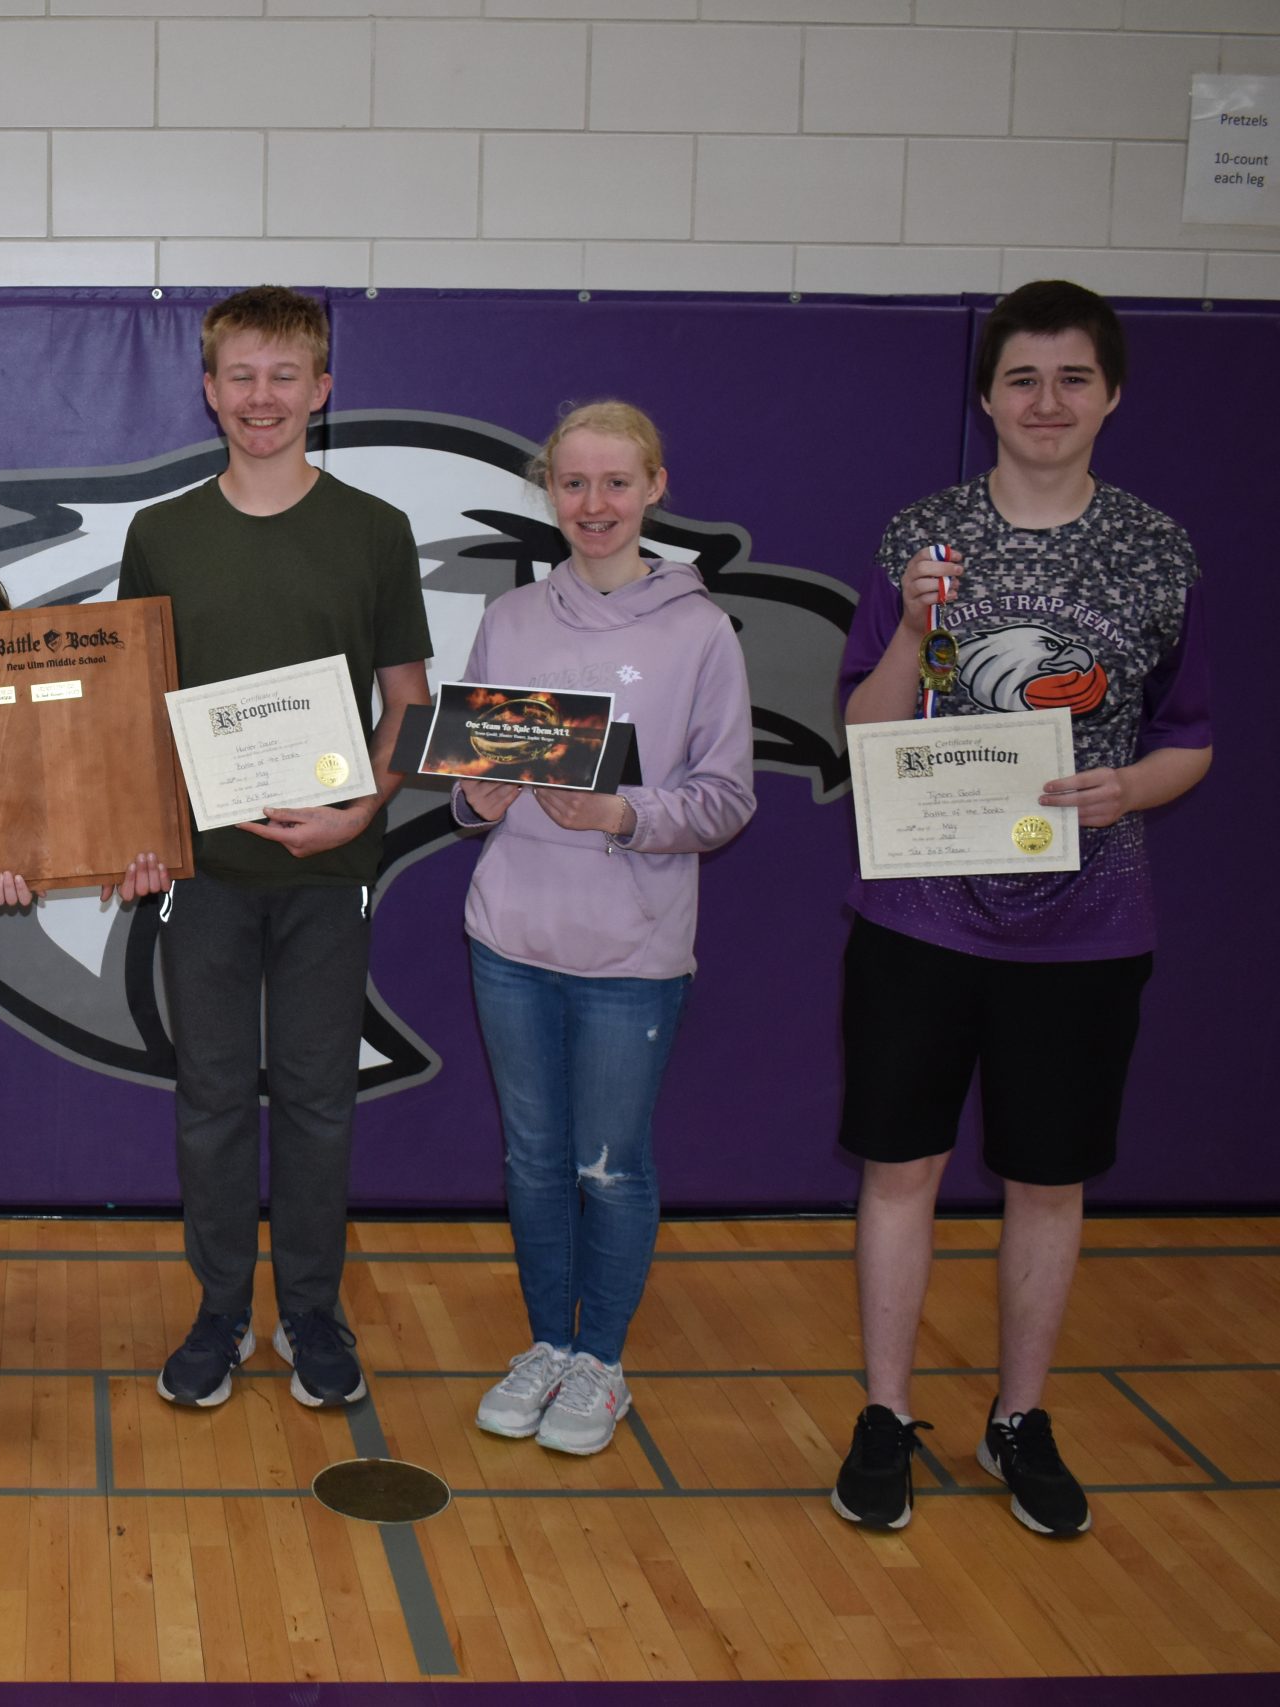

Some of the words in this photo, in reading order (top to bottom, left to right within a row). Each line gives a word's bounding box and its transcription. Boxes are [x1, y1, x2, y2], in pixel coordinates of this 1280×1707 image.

[1220, 113, 1268, 128] Pretzels
[1214, 152, 1268, 167] 10-count
[1214, 172, 1243, 185] each
[1246, 172, 1264, 188] leg
[1004, 595, 1064, 612] TRAP
[1072, 603, 1125, 650] TEAM
[63, 628, 125, 651] Books
[6, 662, 25, 672] New
[27, 660, 45, 670] Ulm
[46, 658, 76, 668] Middle
[78, 656, 107, 665] School
[216, 697, 310, 730] Recognition
[465, 720, 480, 729] One
[481, 721, 500, 731] Team
[502, 723, 512, 731] To
[512, 724, 531, 734] Rule
[531, 725, 552, 735] Them
[935, 739, 971, 748] Certificate
[904, 745, 1019, 772] Recognition
